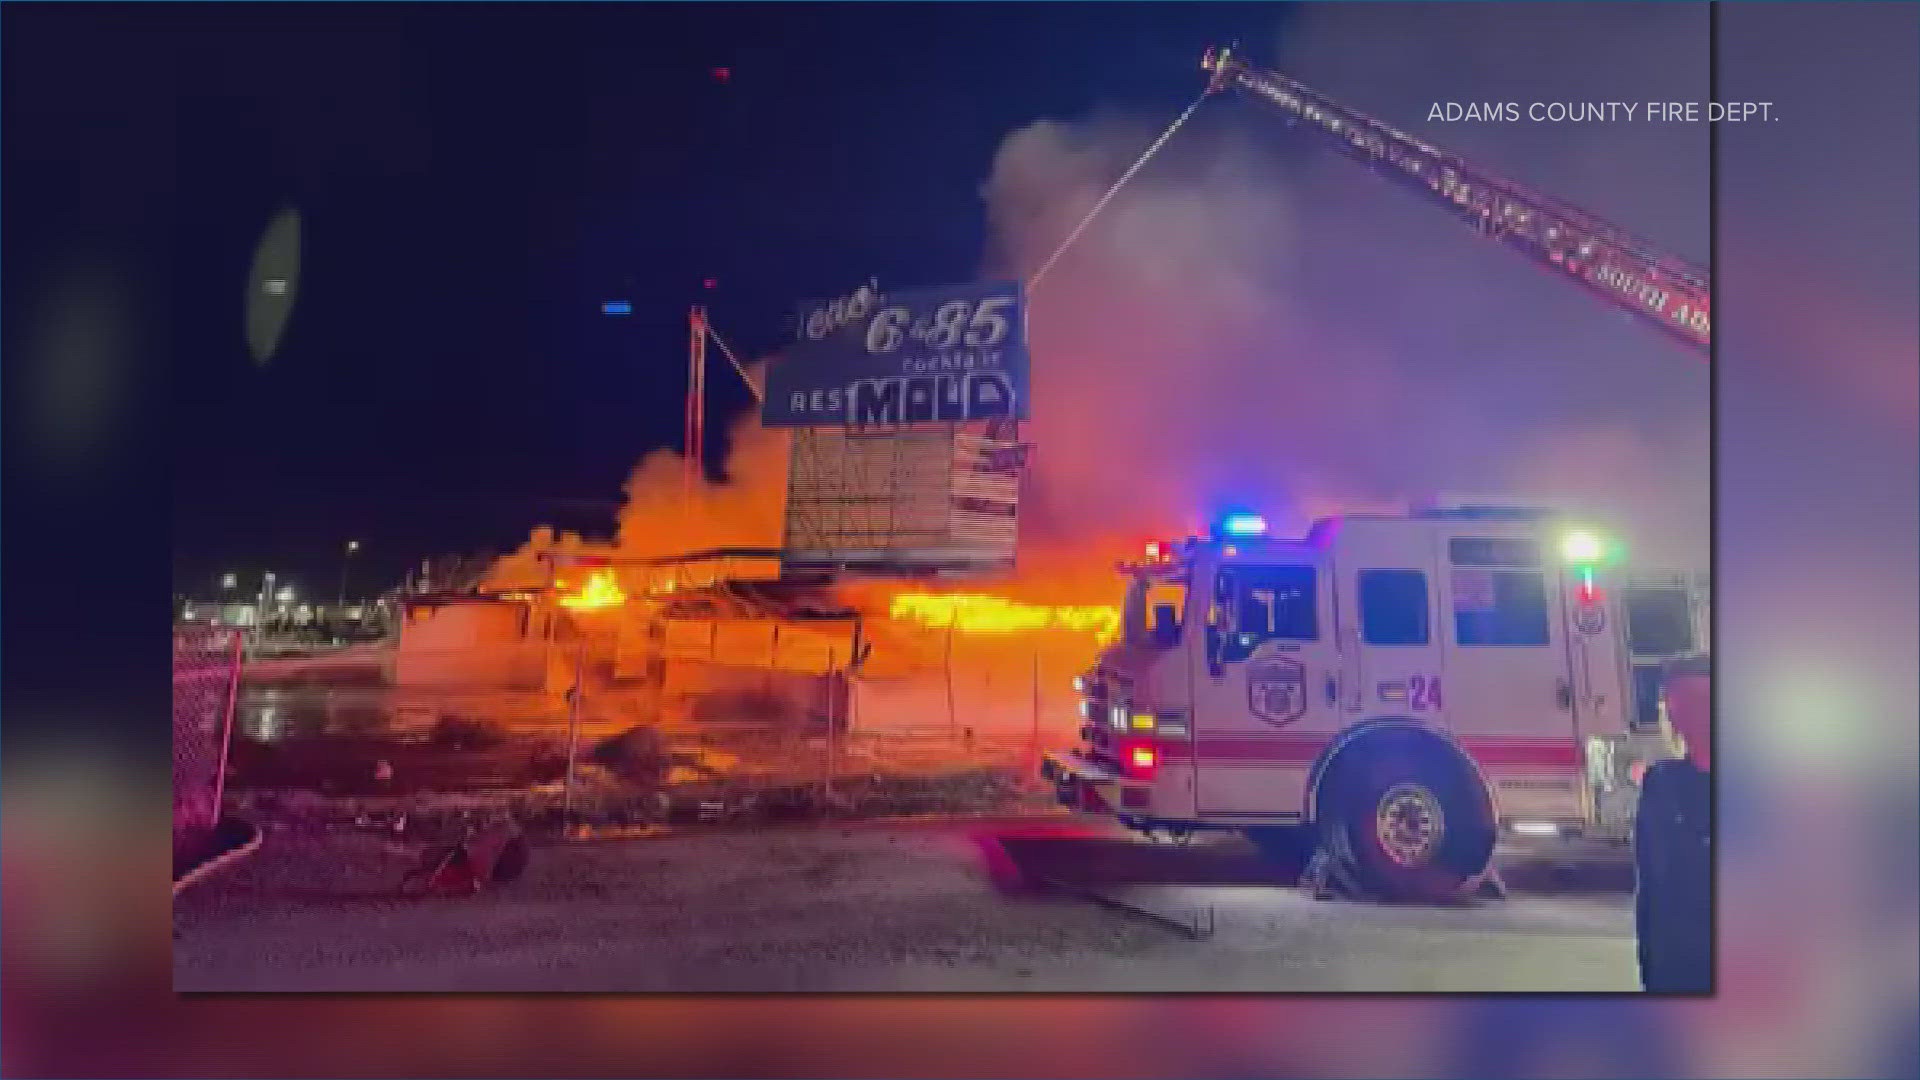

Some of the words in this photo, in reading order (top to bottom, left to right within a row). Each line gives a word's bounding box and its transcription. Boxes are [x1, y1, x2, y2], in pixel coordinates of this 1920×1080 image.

[1597, 263, 1670, 313] SOUTH
[866, 307, 910, 352] 6
[1410, 674, 1442, 711] 24
